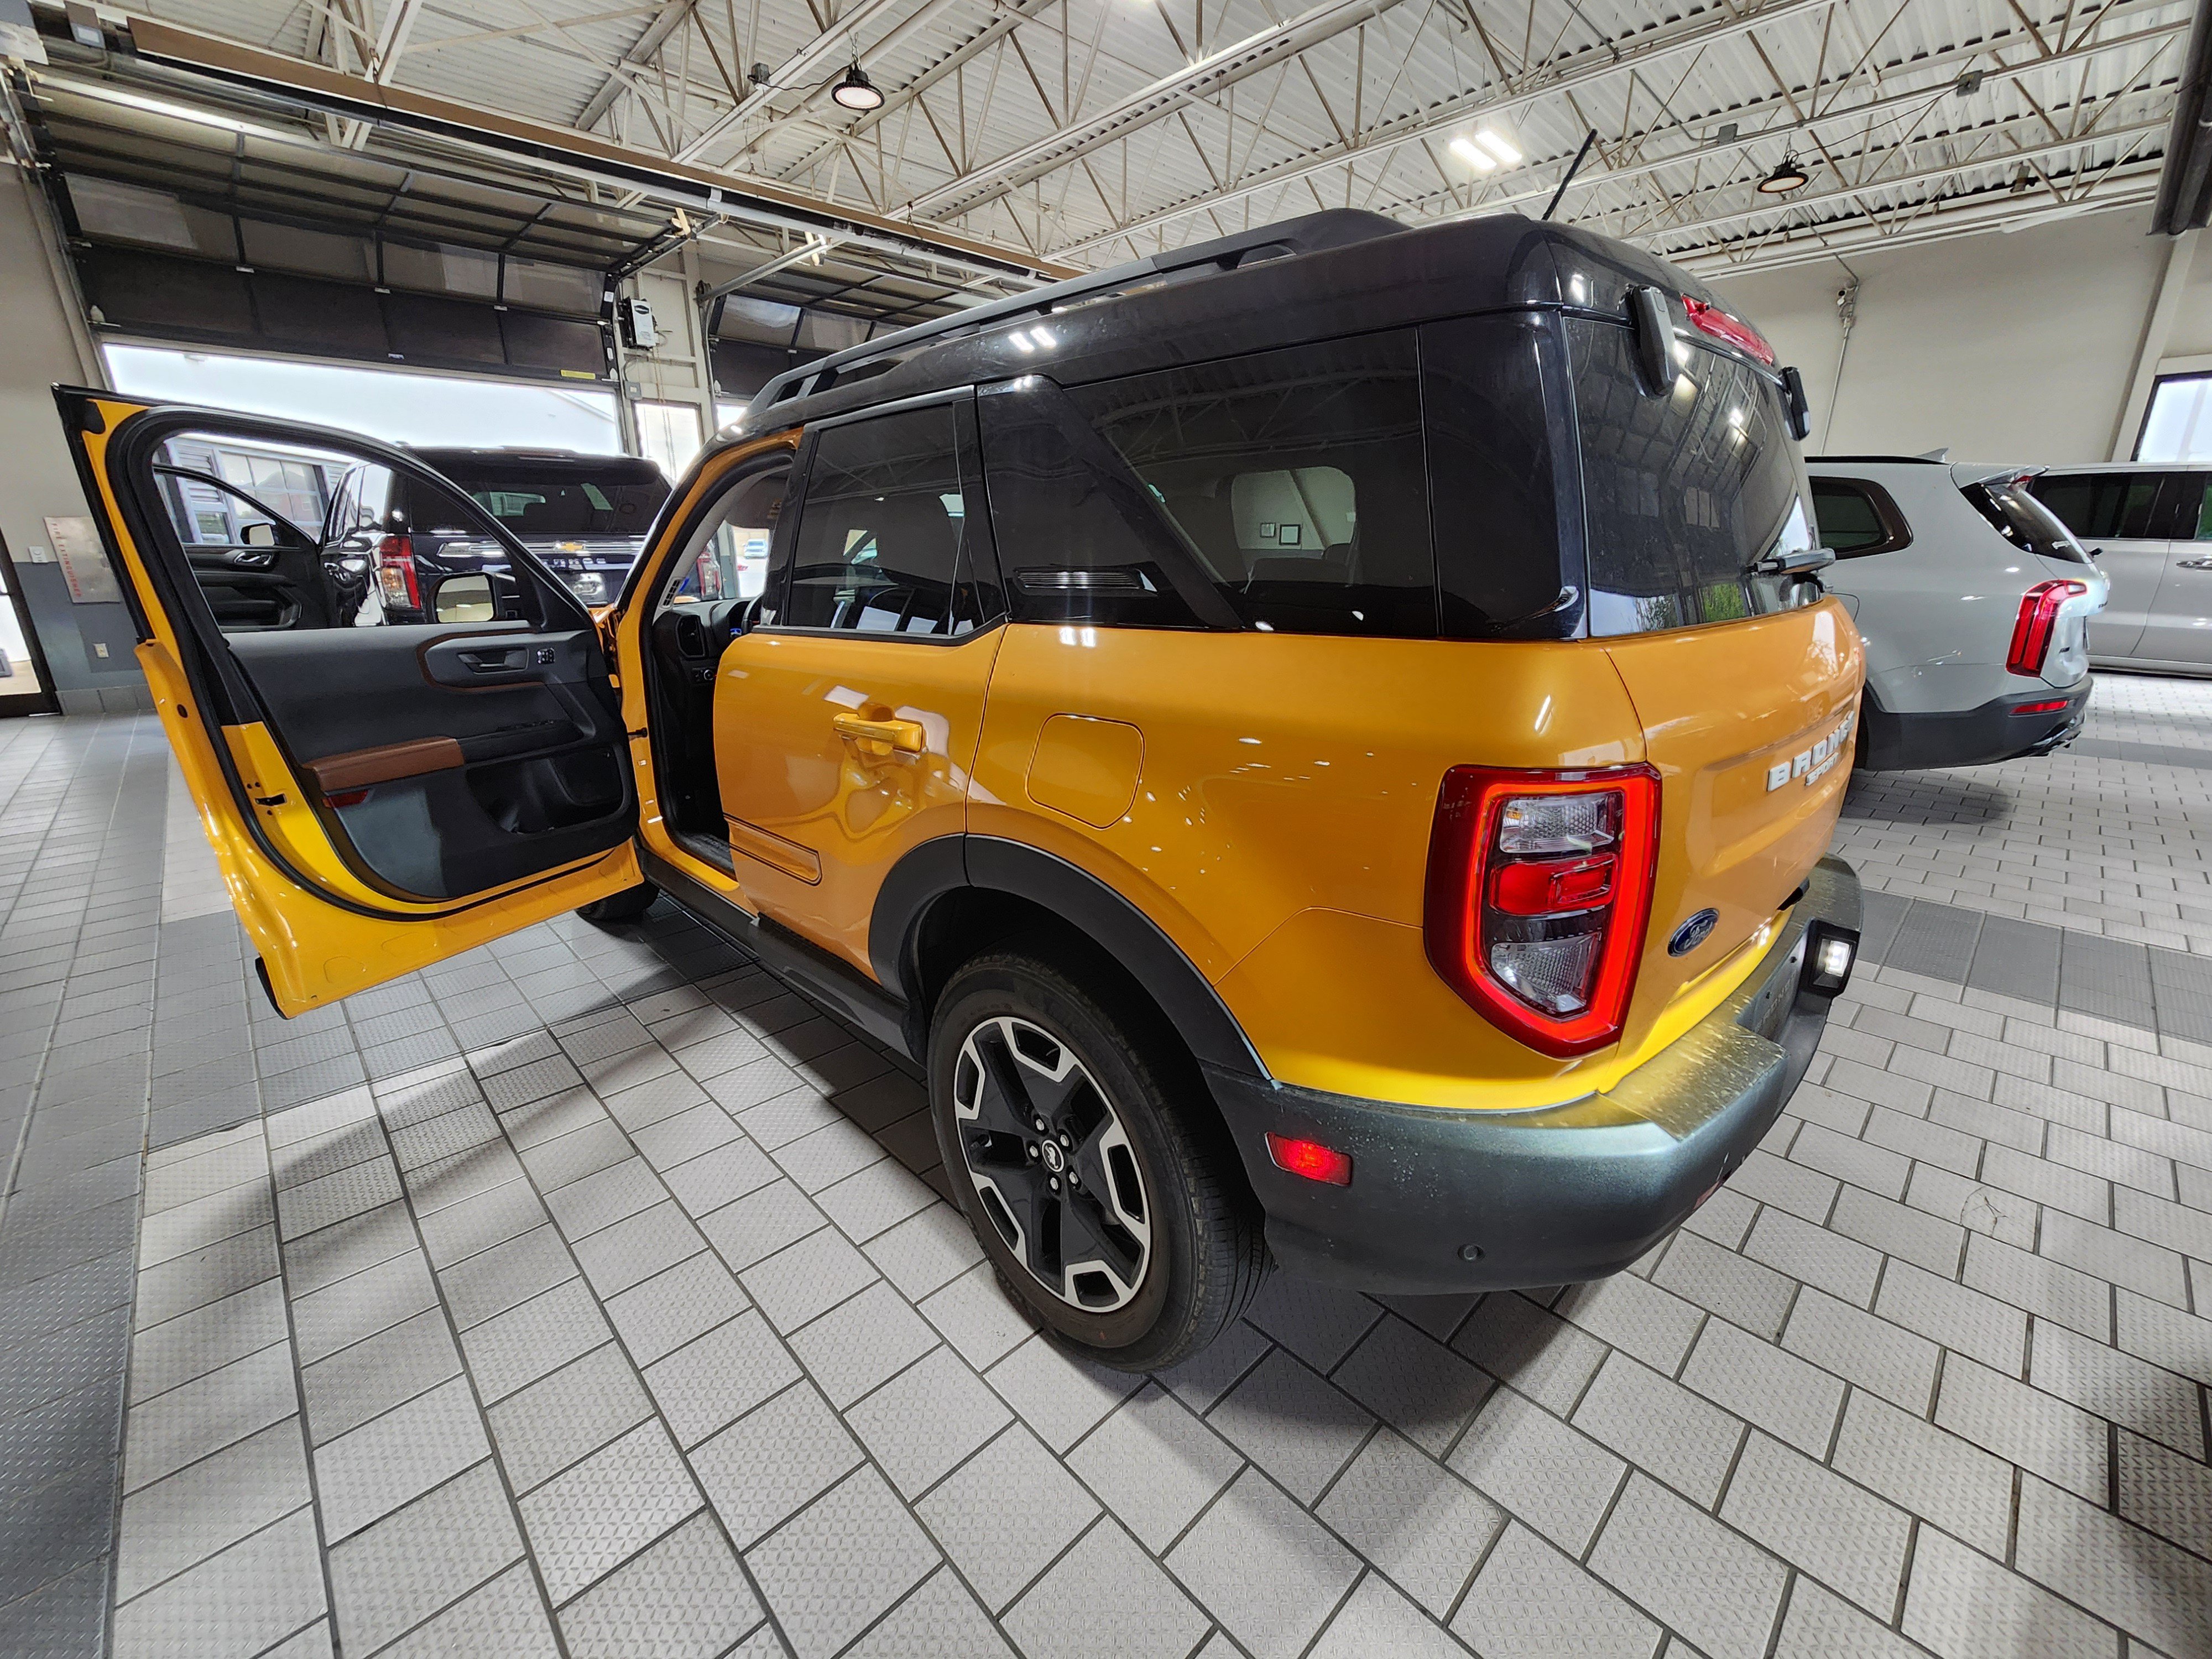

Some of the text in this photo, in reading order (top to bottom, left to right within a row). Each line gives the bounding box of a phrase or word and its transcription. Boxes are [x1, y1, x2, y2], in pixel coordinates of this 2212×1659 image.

[51, 523, 63, 540] FIRE
[1805, 752, 1839, 786] SPORT
[1683, 919, 1713, 950] Ford
